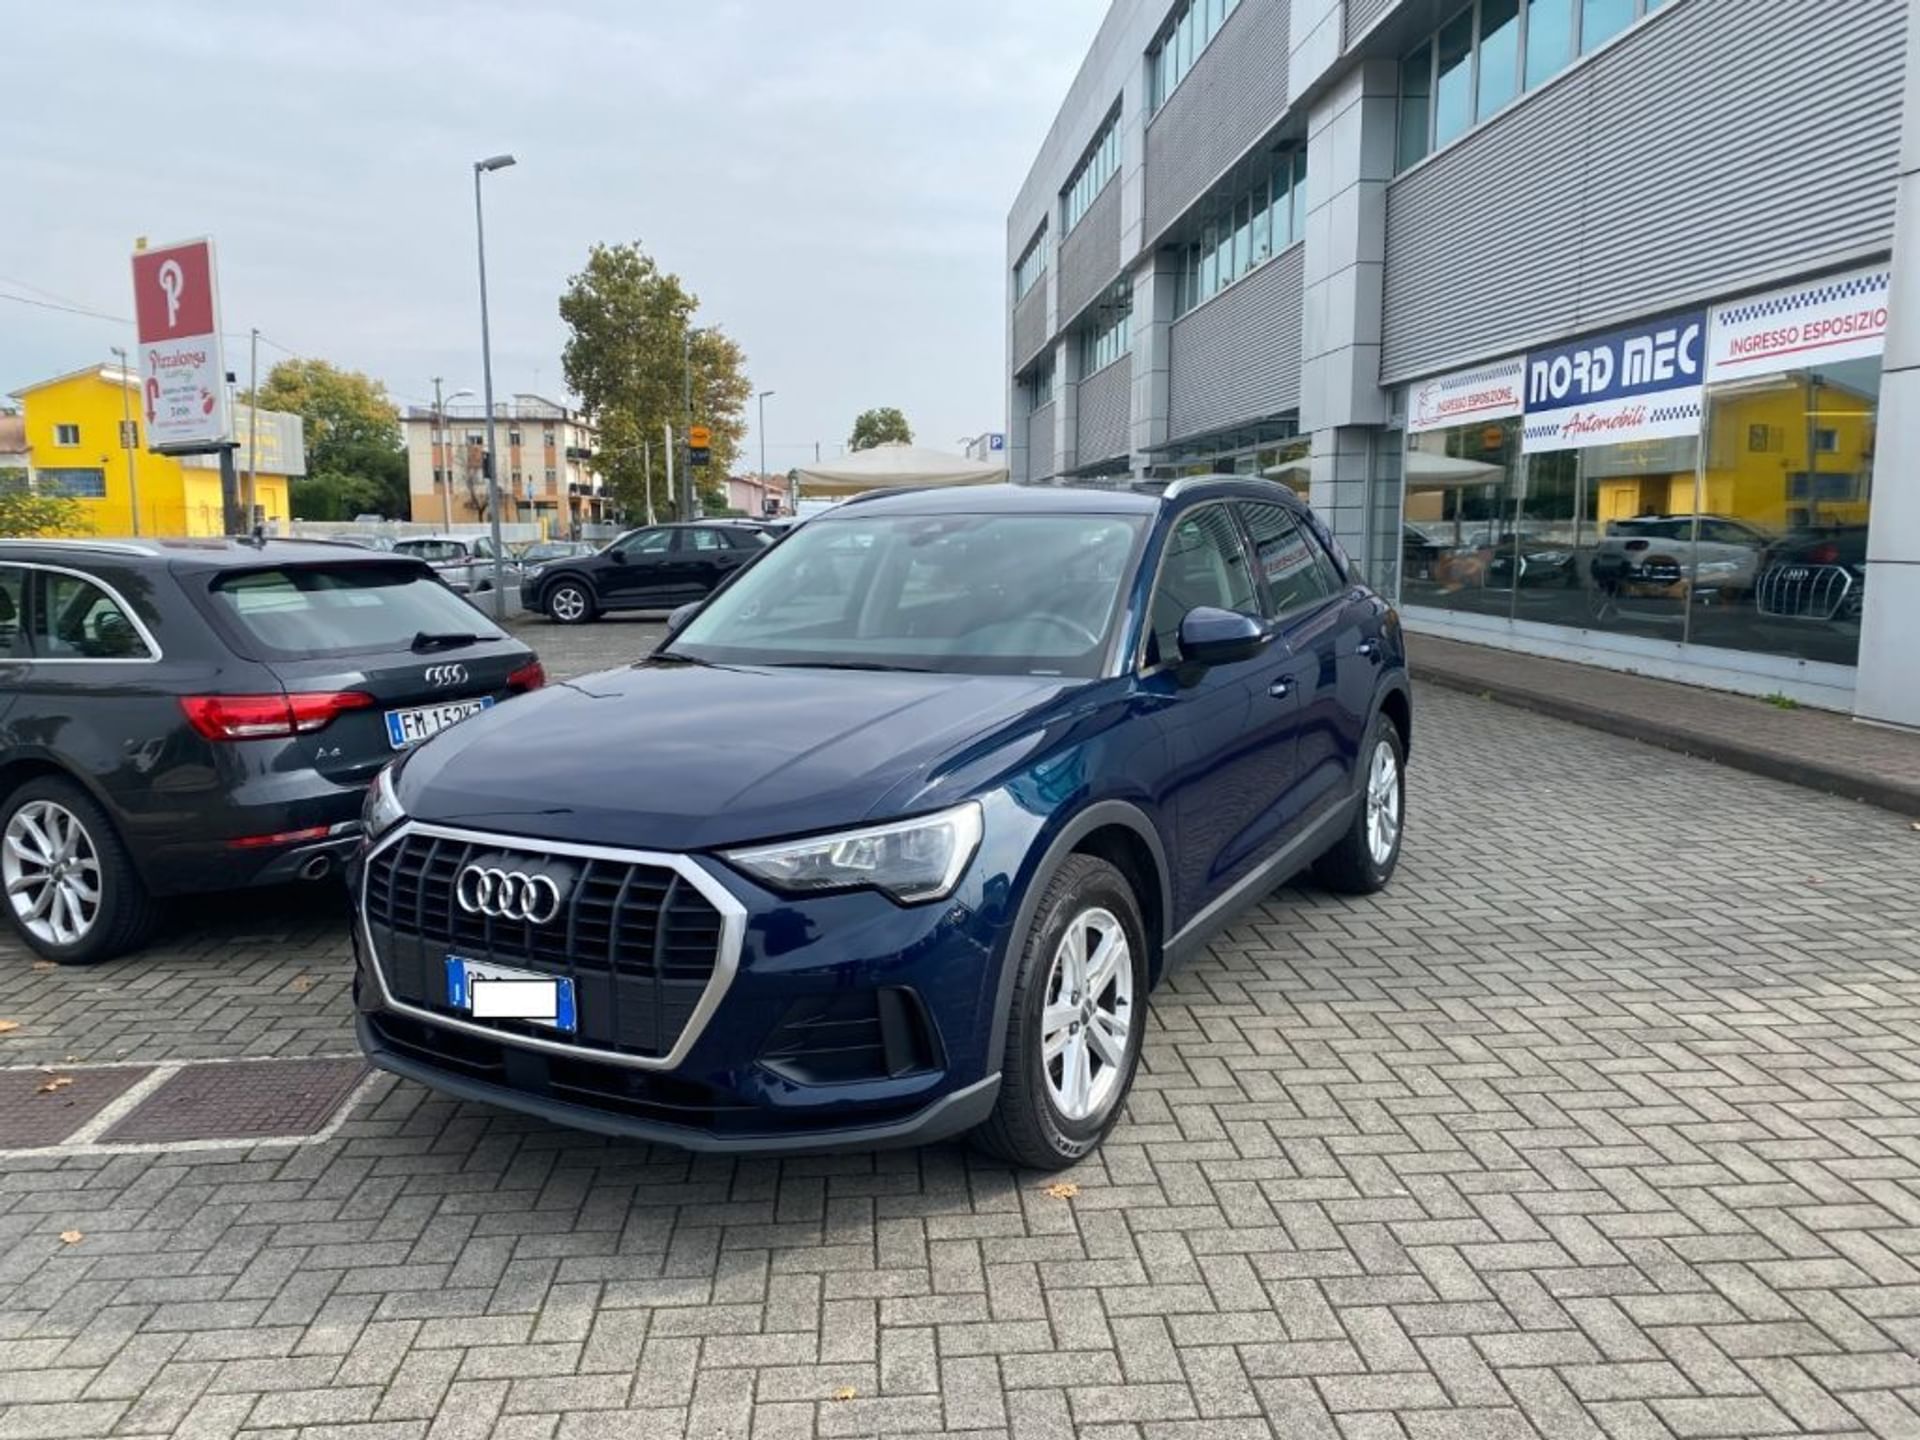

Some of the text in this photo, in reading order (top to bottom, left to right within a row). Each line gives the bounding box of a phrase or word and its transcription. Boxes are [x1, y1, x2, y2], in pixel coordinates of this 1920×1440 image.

[1729, 326, 1800, 356] INGRESSO
[1530, 323, 1700, 405] NORD MEC
[1561, 403, 1648, 440] Automobili
[402, 711, 427, 738] FM
